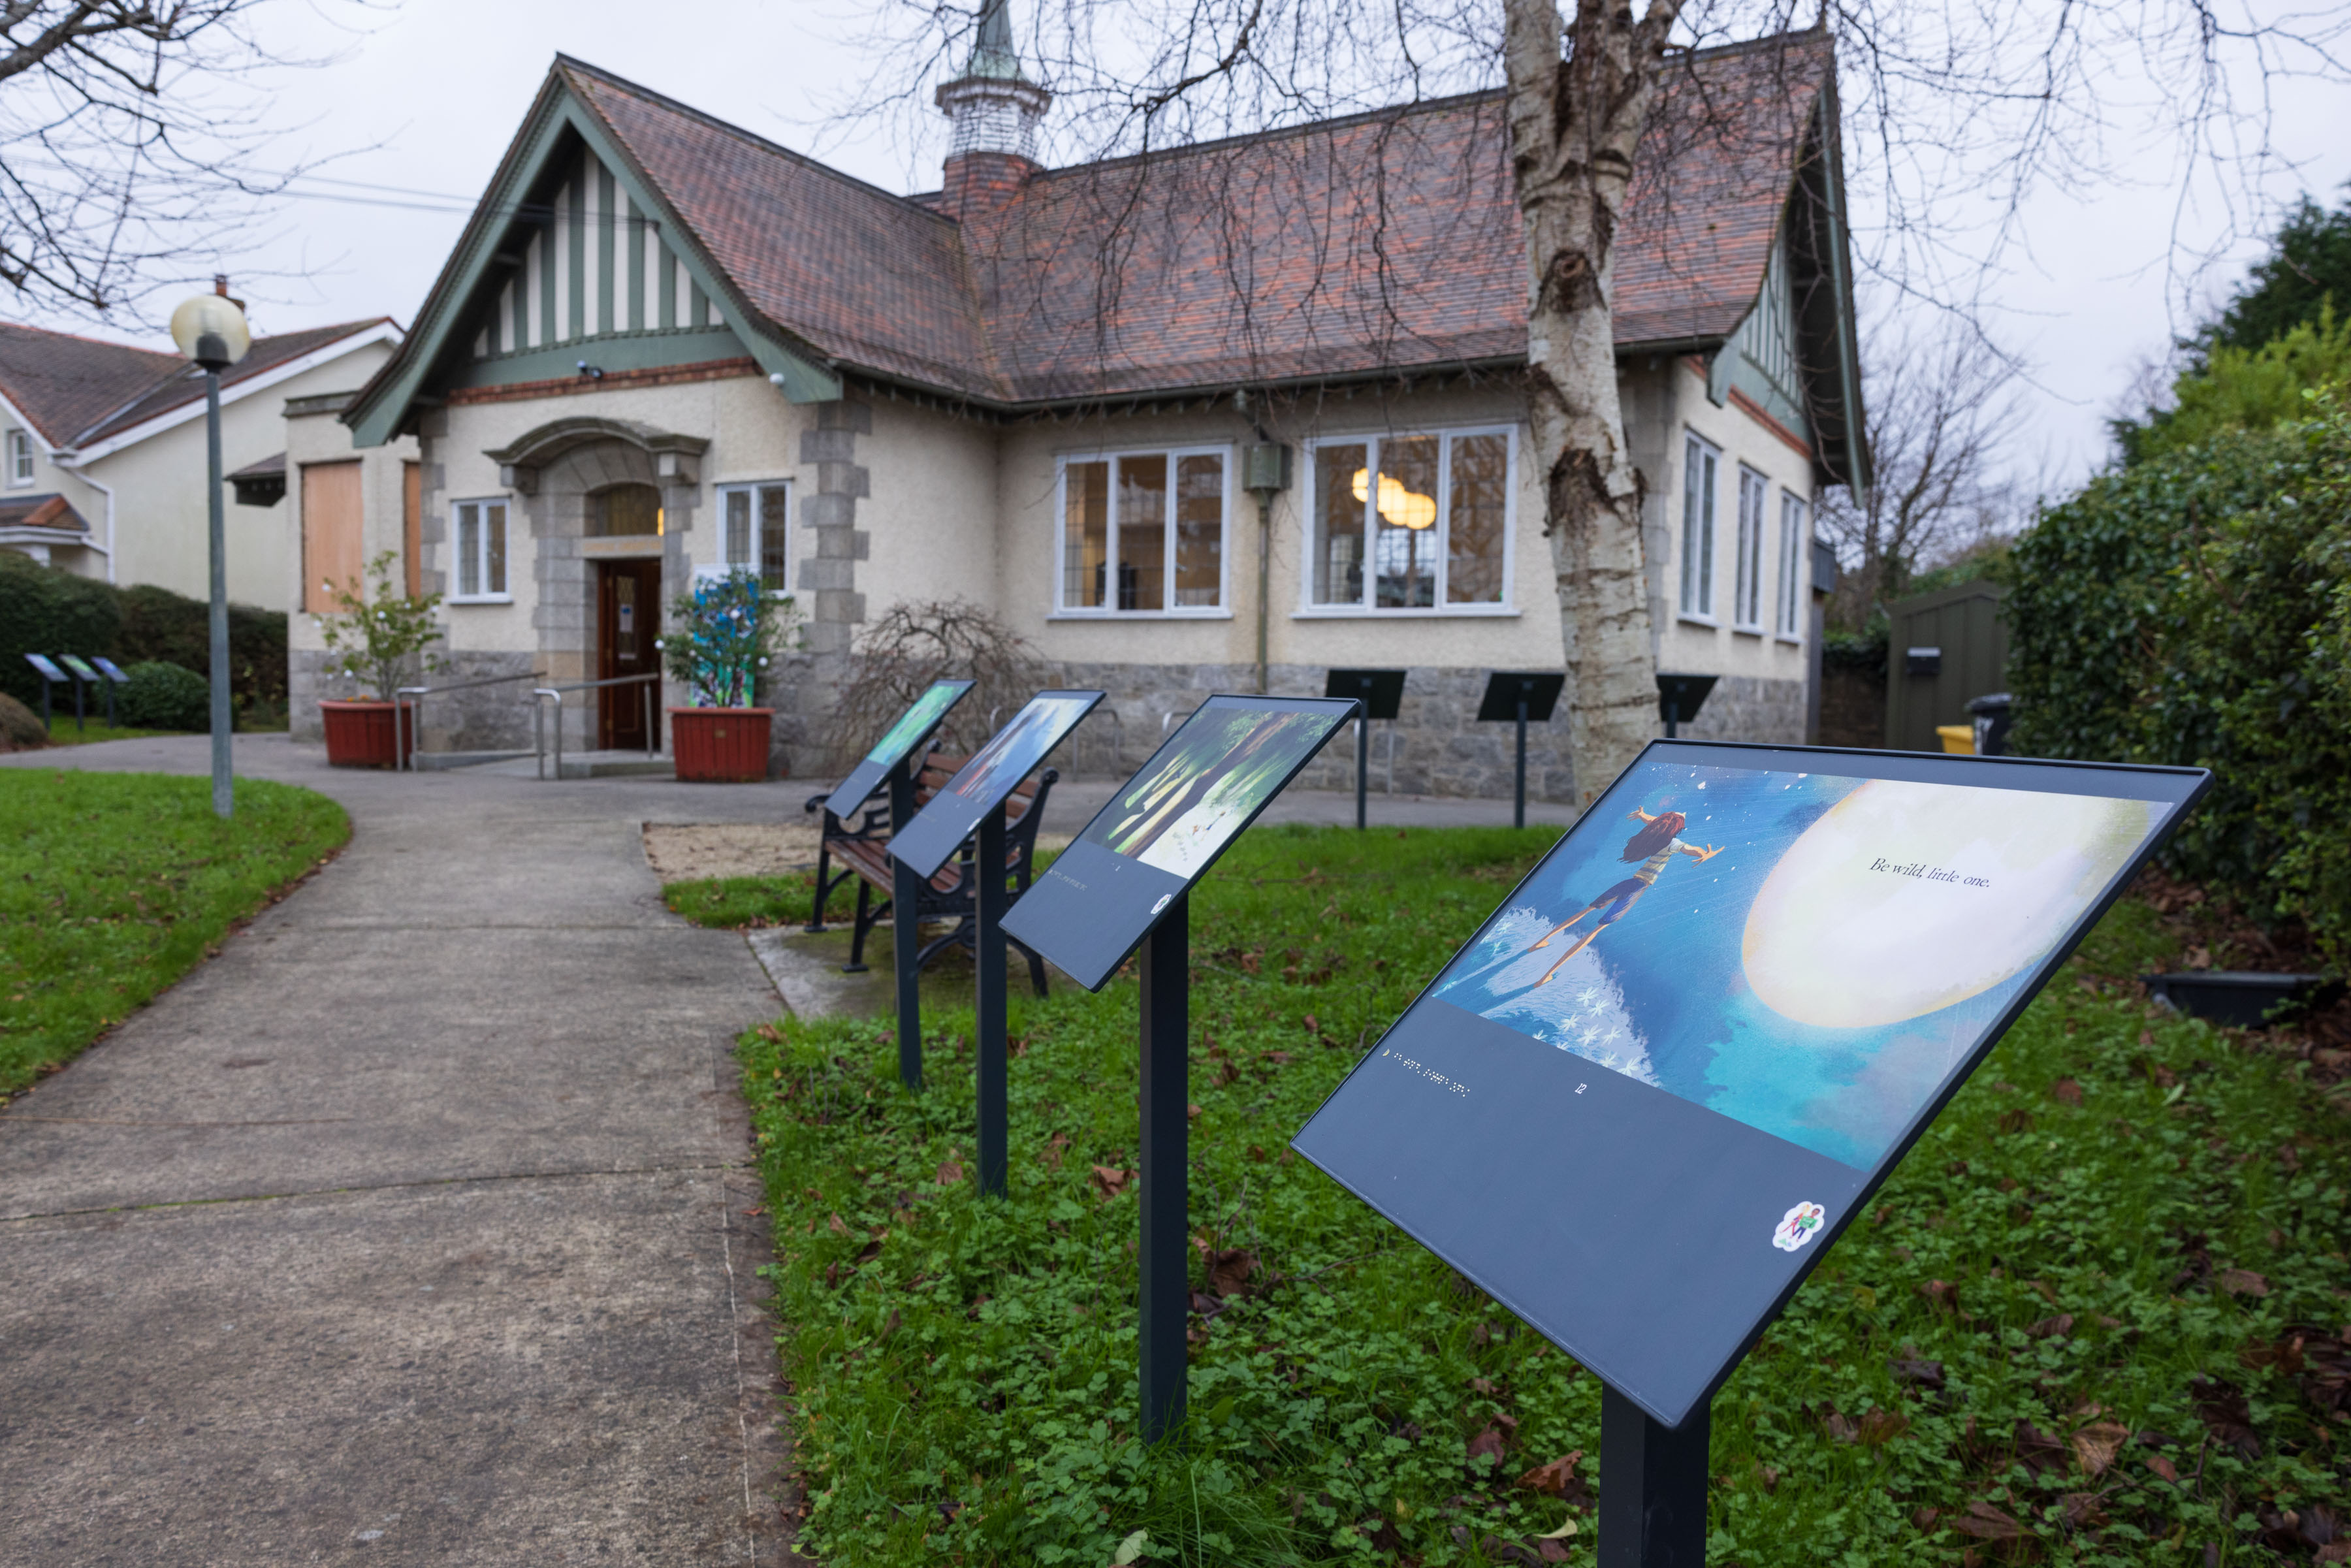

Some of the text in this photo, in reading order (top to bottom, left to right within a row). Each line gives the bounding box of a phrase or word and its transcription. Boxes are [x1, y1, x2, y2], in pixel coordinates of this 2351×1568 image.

[1868, 857, 1990, 888] Be wild, little one.
[1575, 1083, 1588, 1095] 12
